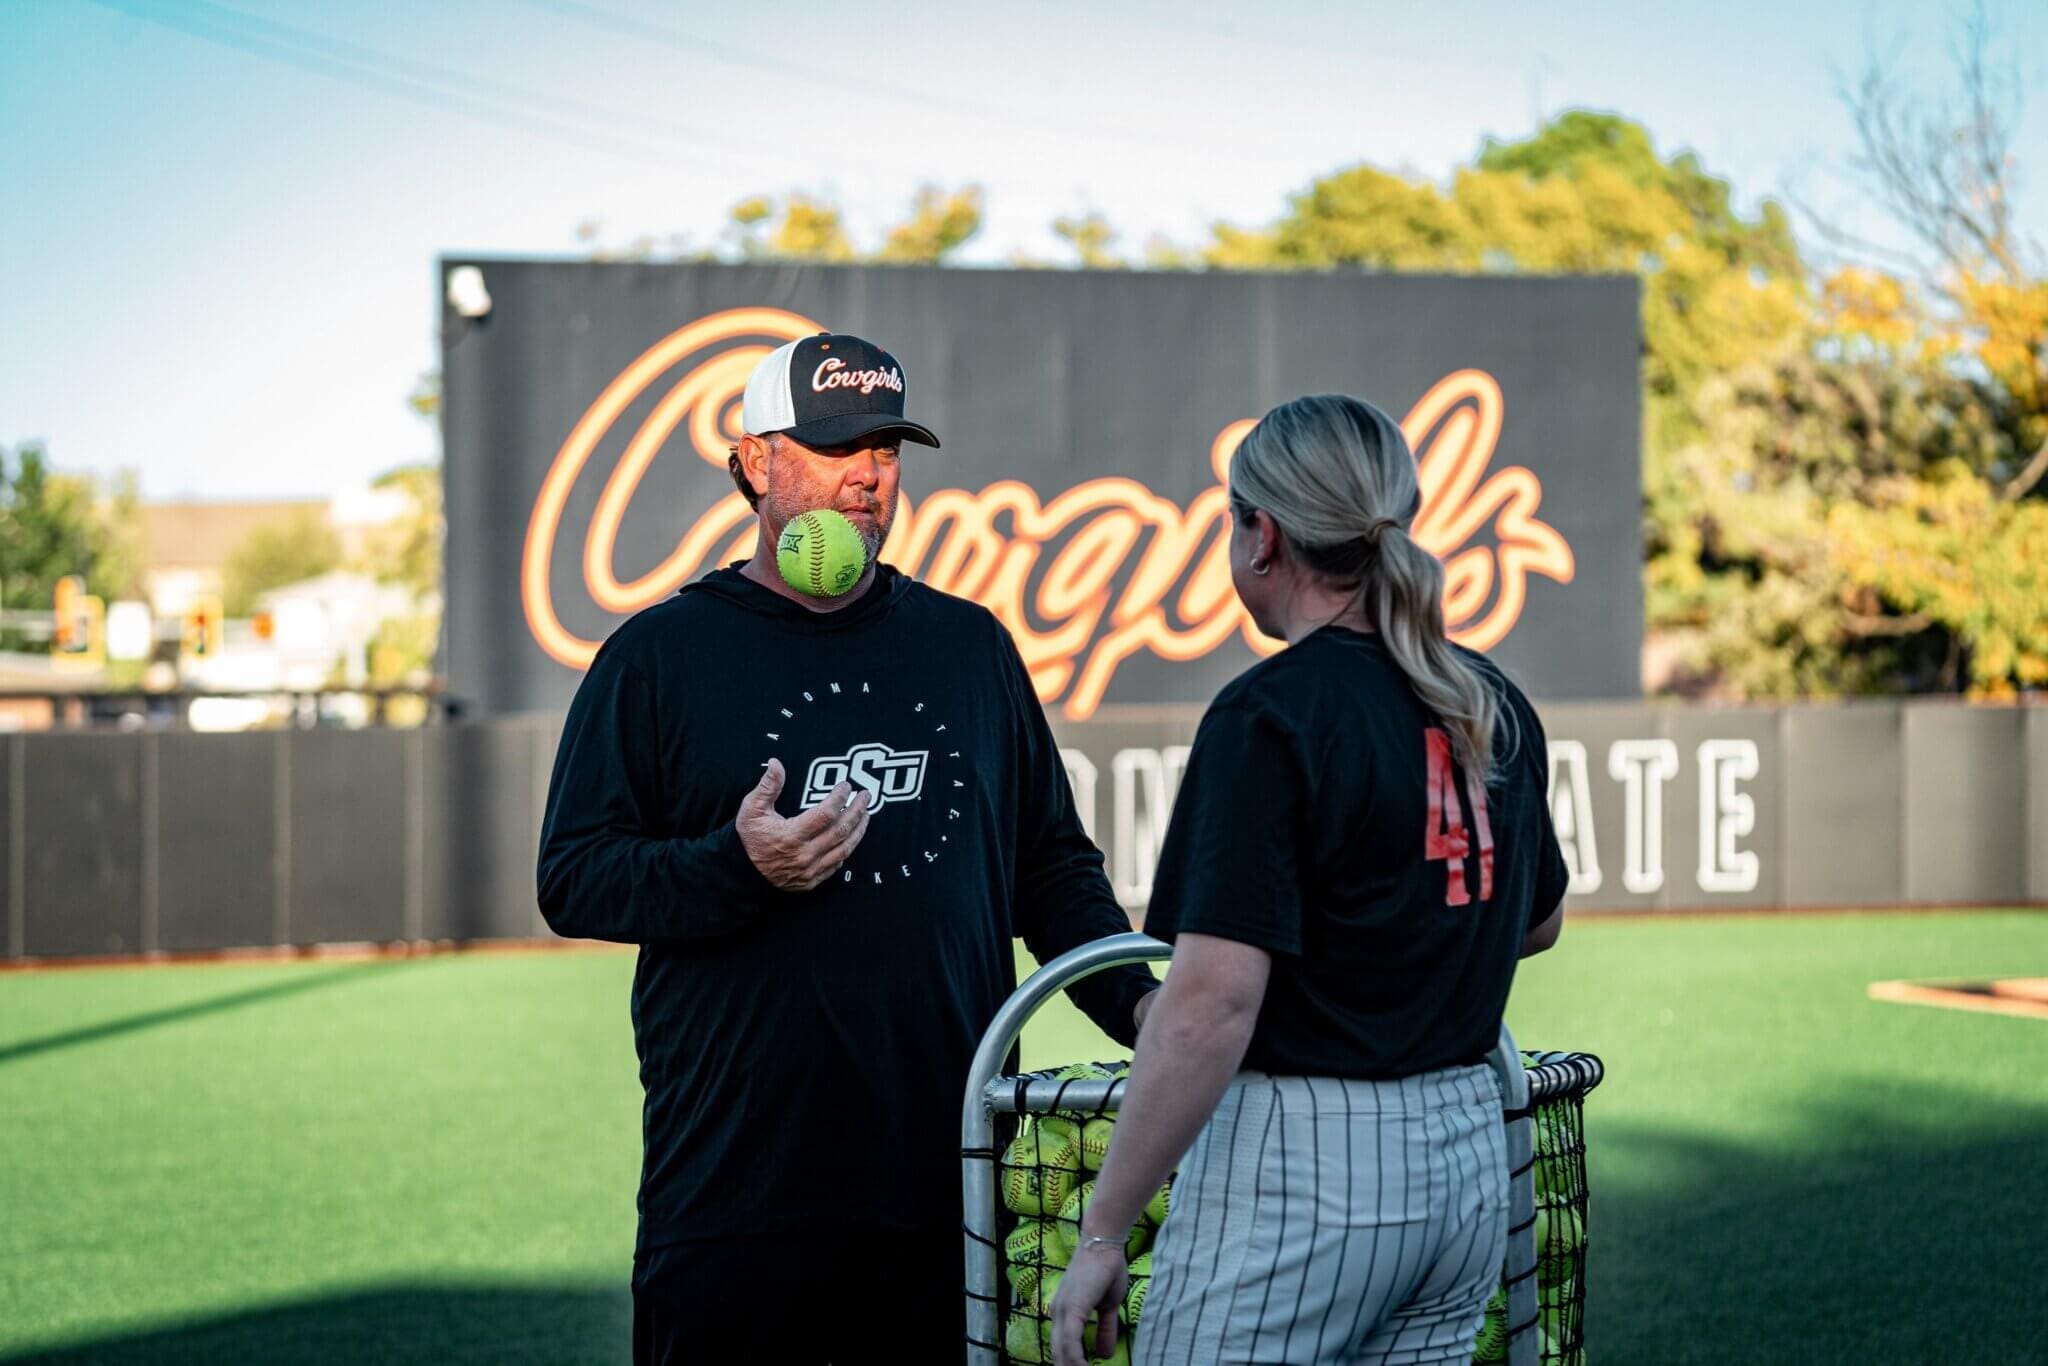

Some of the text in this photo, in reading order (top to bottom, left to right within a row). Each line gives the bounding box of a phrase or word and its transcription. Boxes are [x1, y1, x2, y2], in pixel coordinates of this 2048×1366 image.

[812, 357, 903, 395] Cowgirls
[521, 307, 1575, 720] Cwgils
[760, 682, 871, 767] AHOMA
[800, 742, 929, 816] OSU
[1547, 739, 1759, 894] ATE
[844, 851, 938, 885] OKES
